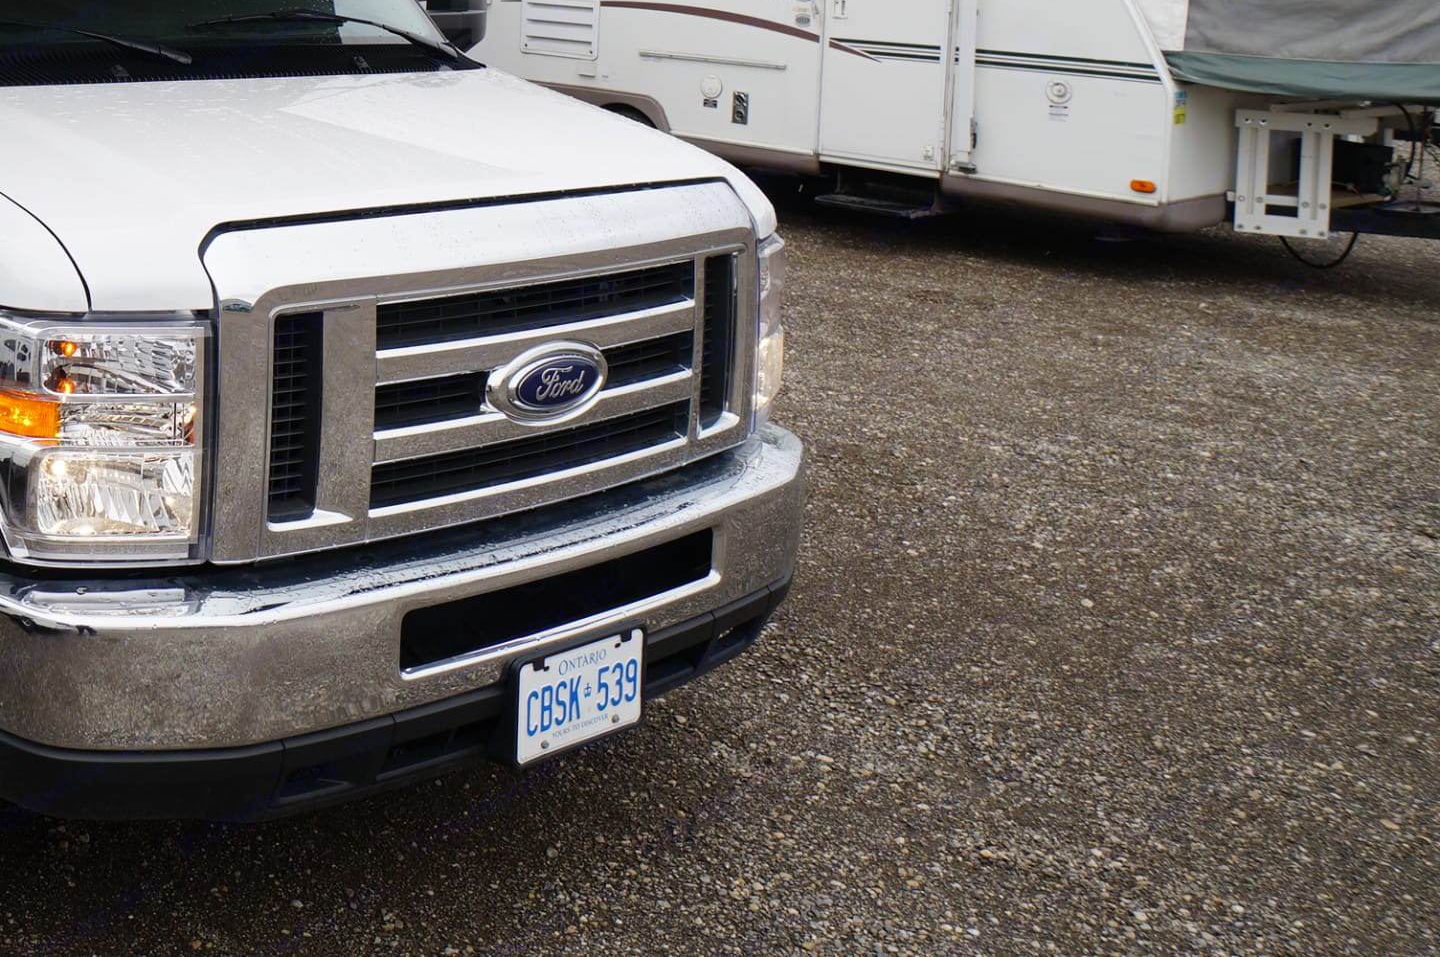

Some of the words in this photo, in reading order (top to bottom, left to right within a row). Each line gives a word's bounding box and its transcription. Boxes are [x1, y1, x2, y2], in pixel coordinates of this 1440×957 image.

[535, 365, 585, 401] Ford
[526, 674, 582, 737] CBSK
[597, 658, 638, 711] 539
